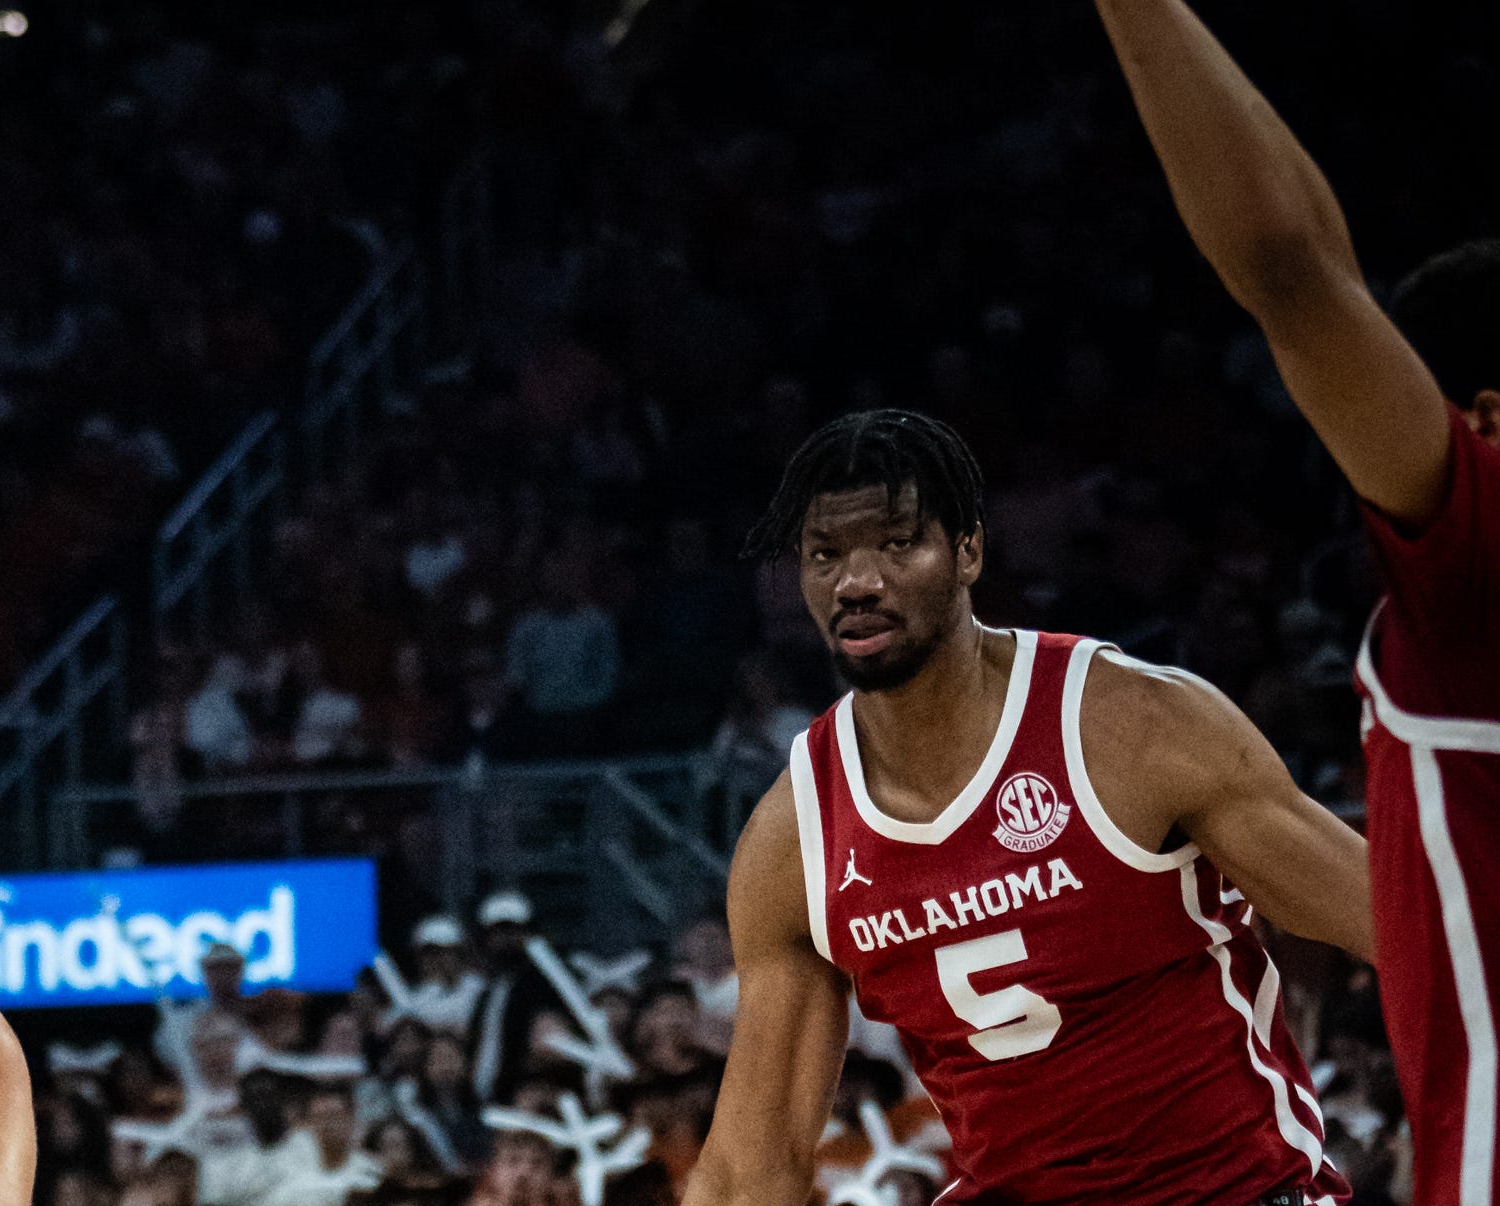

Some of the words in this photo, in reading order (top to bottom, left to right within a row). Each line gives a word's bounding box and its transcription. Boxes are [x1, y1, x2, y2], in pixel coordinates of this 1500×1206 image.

[1001, 777, 1052, 832] SEC
[1003, 819, 1065, 851] GRADUATE
[849, 858, 1083, 952] OKLAHOMA
[934, 929, 1062, 1061] 5
